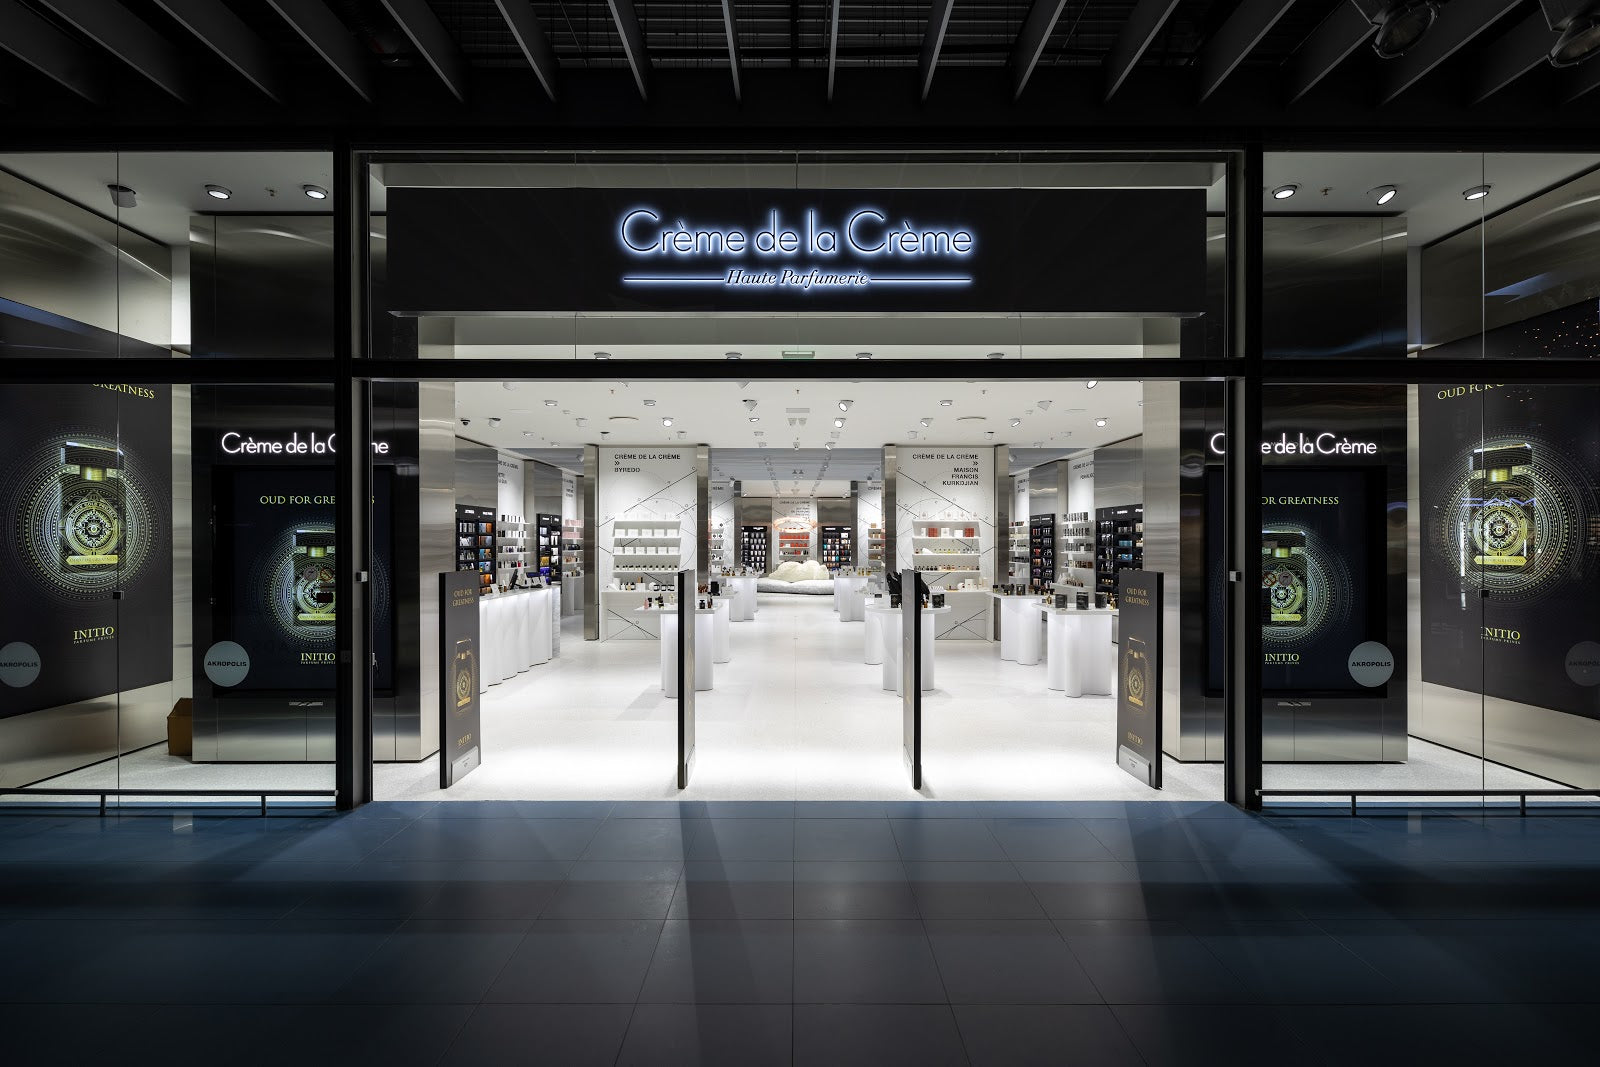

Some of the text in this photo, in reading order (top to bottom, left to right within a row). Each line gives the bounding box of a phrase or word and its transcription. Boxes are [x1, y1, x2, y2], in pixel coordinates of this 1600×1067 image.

[620, 208, 973, 253] Crème de la Crème
[725, 268, 869, 290] Haute Parfumerie
[92, 383, 155, 399] EATNESS
[1437, 386, 1466, 400] OUD
[221, 432, 283, 454] Crème
[285, 432, 308, 454] de
[311, 432, 326, 454] la
[1274, 432, 1296, 454] de
[1299, 432, 1314, 454] la
[1316, 432, 1377, 454] Crème
[259, 495, 286, 505] OUD
[289, 495, 312, 505] FOR
[1261, 496, 1339, 505] OR GREATNESS
[73, 626, 115, 641] INITIO
[300, 652, 336, 661] INITIO
[1264, 653, 1300, 662] INITIO
